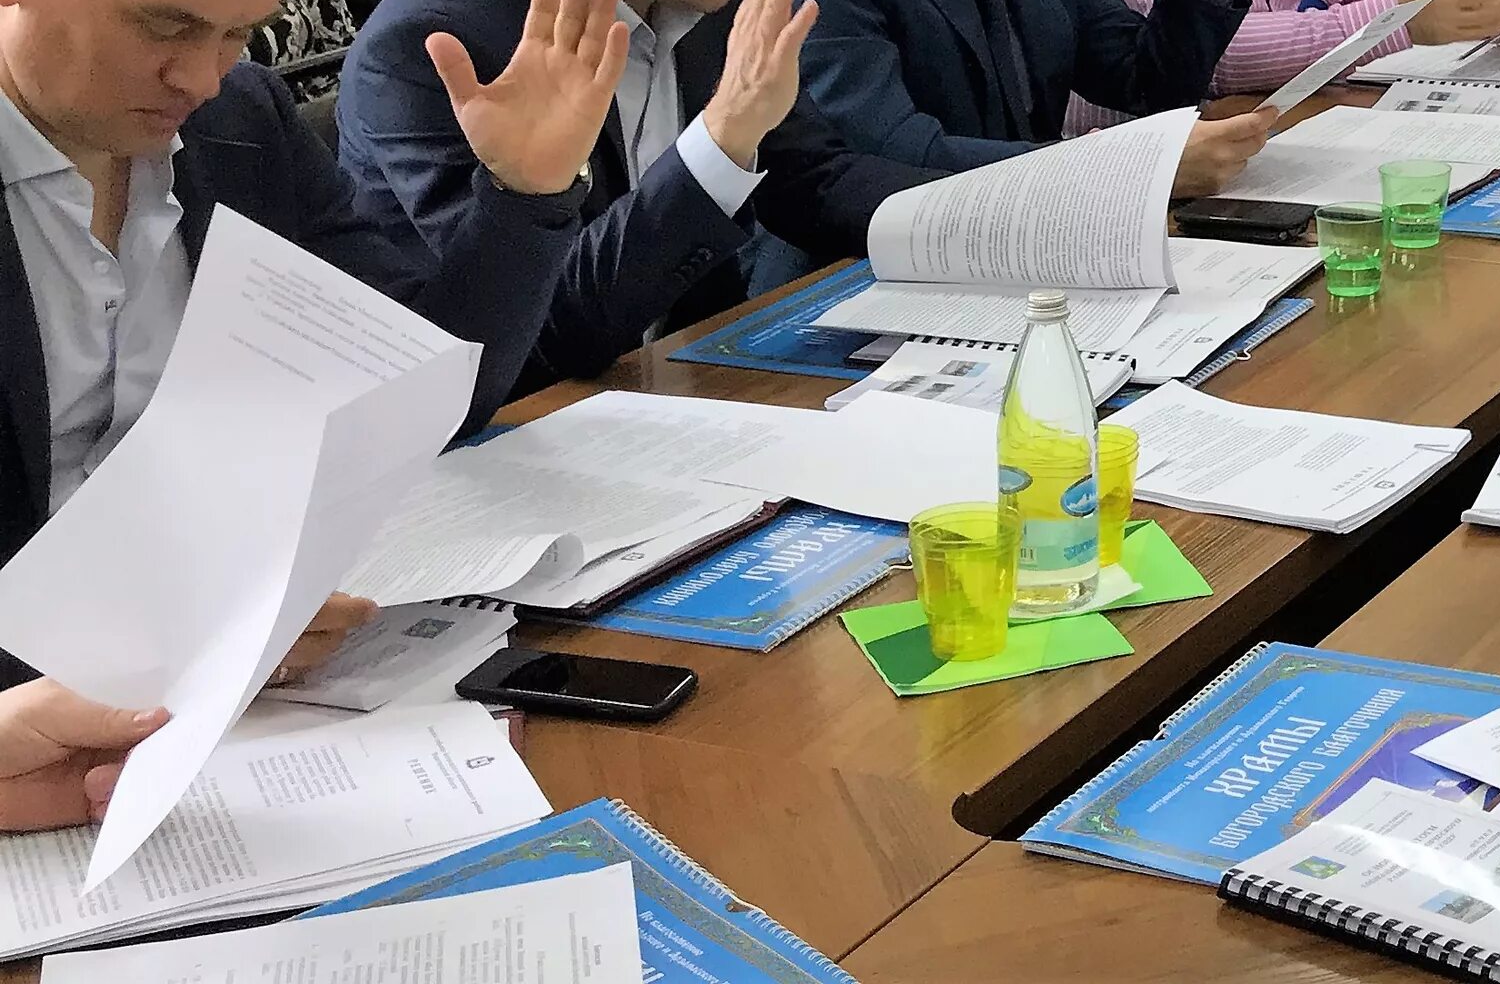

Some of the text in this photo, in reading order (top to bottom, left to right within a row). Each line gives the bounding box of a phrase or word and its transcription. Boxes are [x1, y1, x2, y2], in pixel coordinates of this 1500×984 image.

[738, 522, 861, 582] ХРАМЫ
[1204, 716, 1327, 799] ХРАМЫ
[1208, 761, 1326, 849] БОГОРОДСКОГО
[1312, 688, 1406, 758] БЛАГОЧИНИЯ
